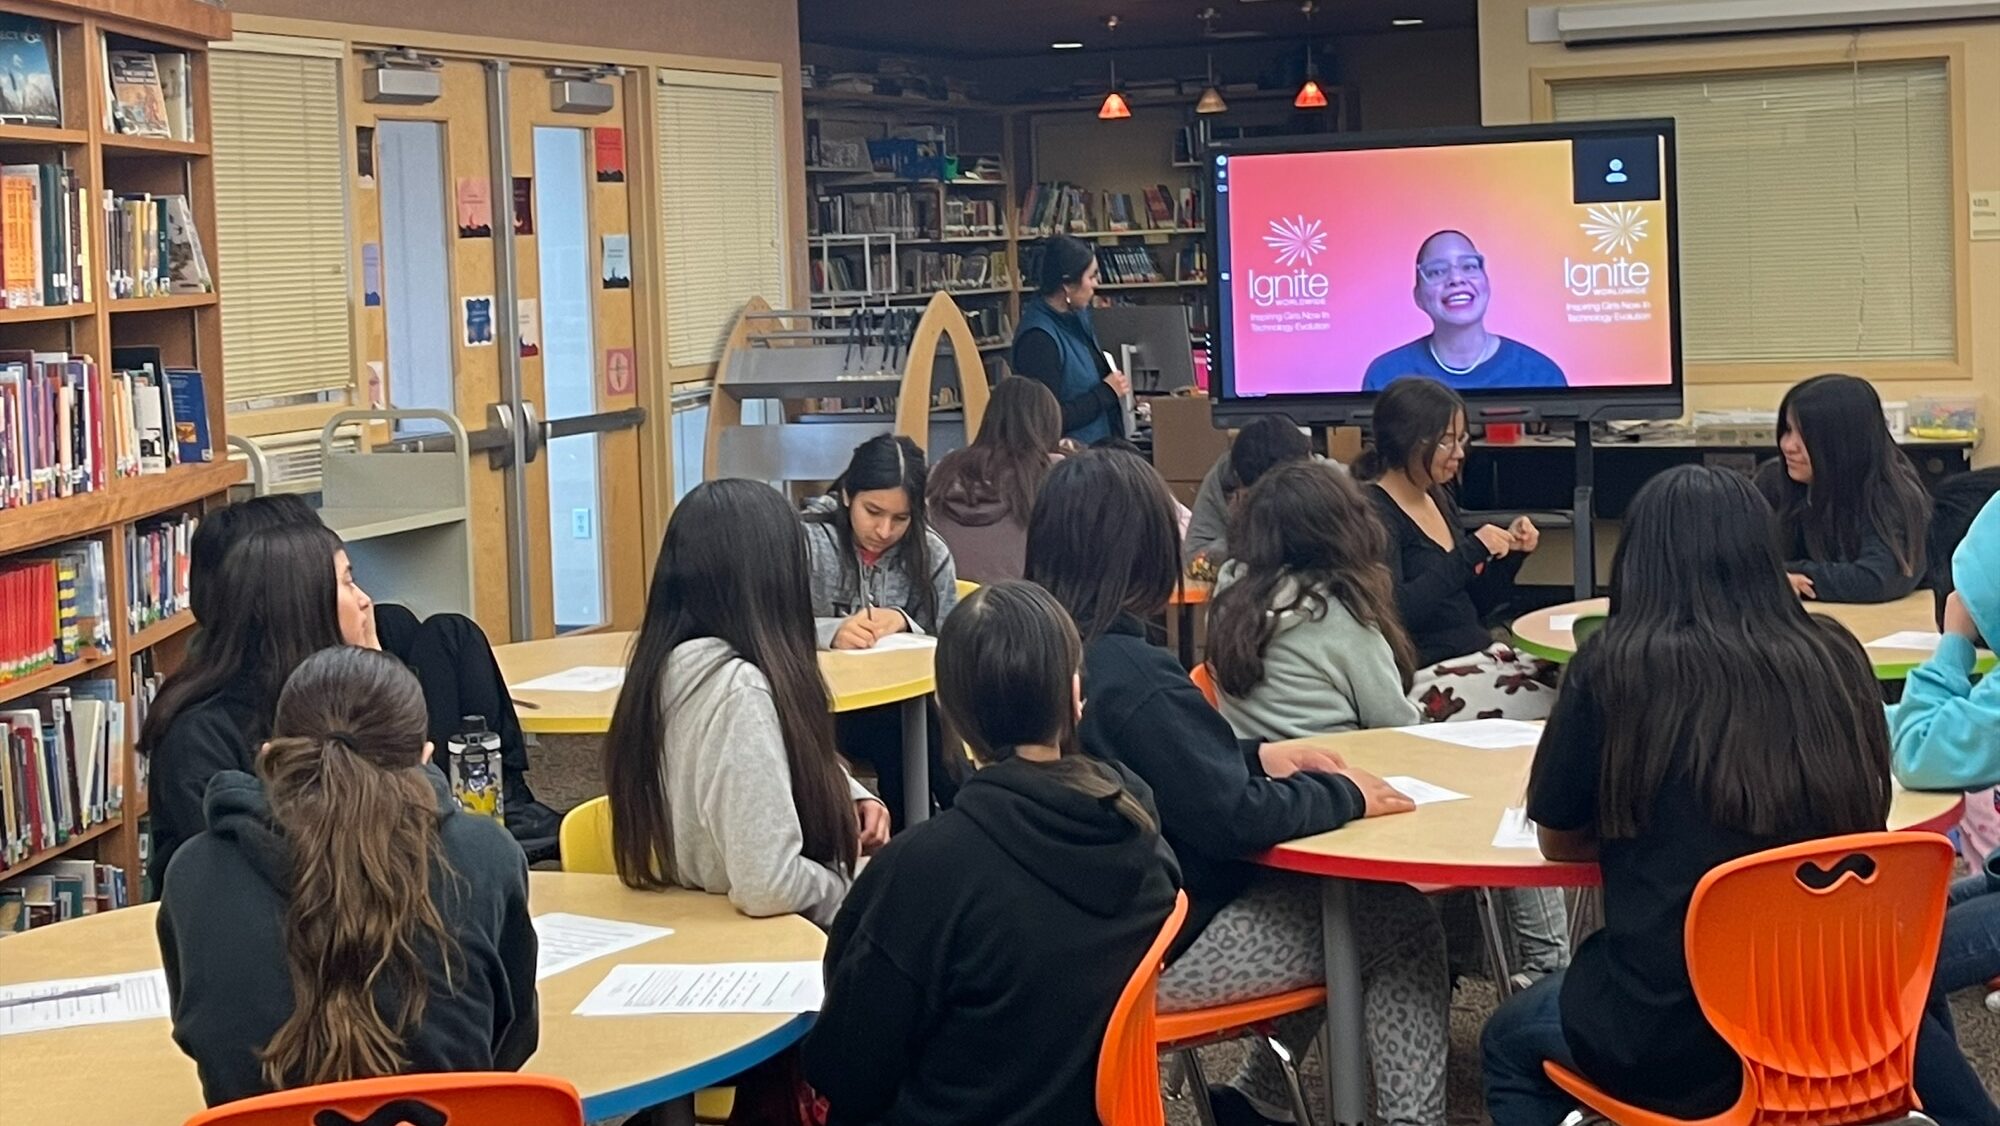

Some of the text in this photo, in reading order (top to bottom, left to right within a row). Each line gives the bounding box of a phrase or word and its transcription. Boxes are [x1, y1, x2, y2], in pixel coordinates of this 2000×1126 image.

[1564, 256, 1650, 296] Ignite
[1248, 268, 1329, 307] Ignite
[1592, 287, 1646, 295] WORLDWIDE
[1275, 298, 1326, 306] WORLDWIDE
[1566, 303, 1600, 312] Inspiring
[1601, 301, 1620, 310] Girls
[1621, 301, 1641, 309] Now
[1250, 313, 1283, 322] Inspiring
[1283, 311, 1301, 320] Girls
[1302, 311, 1321, 320] Now
[1568, 312, 1652, 323] Technology Evolution
[1251, 322, 1331, 333] Technology Evolution
